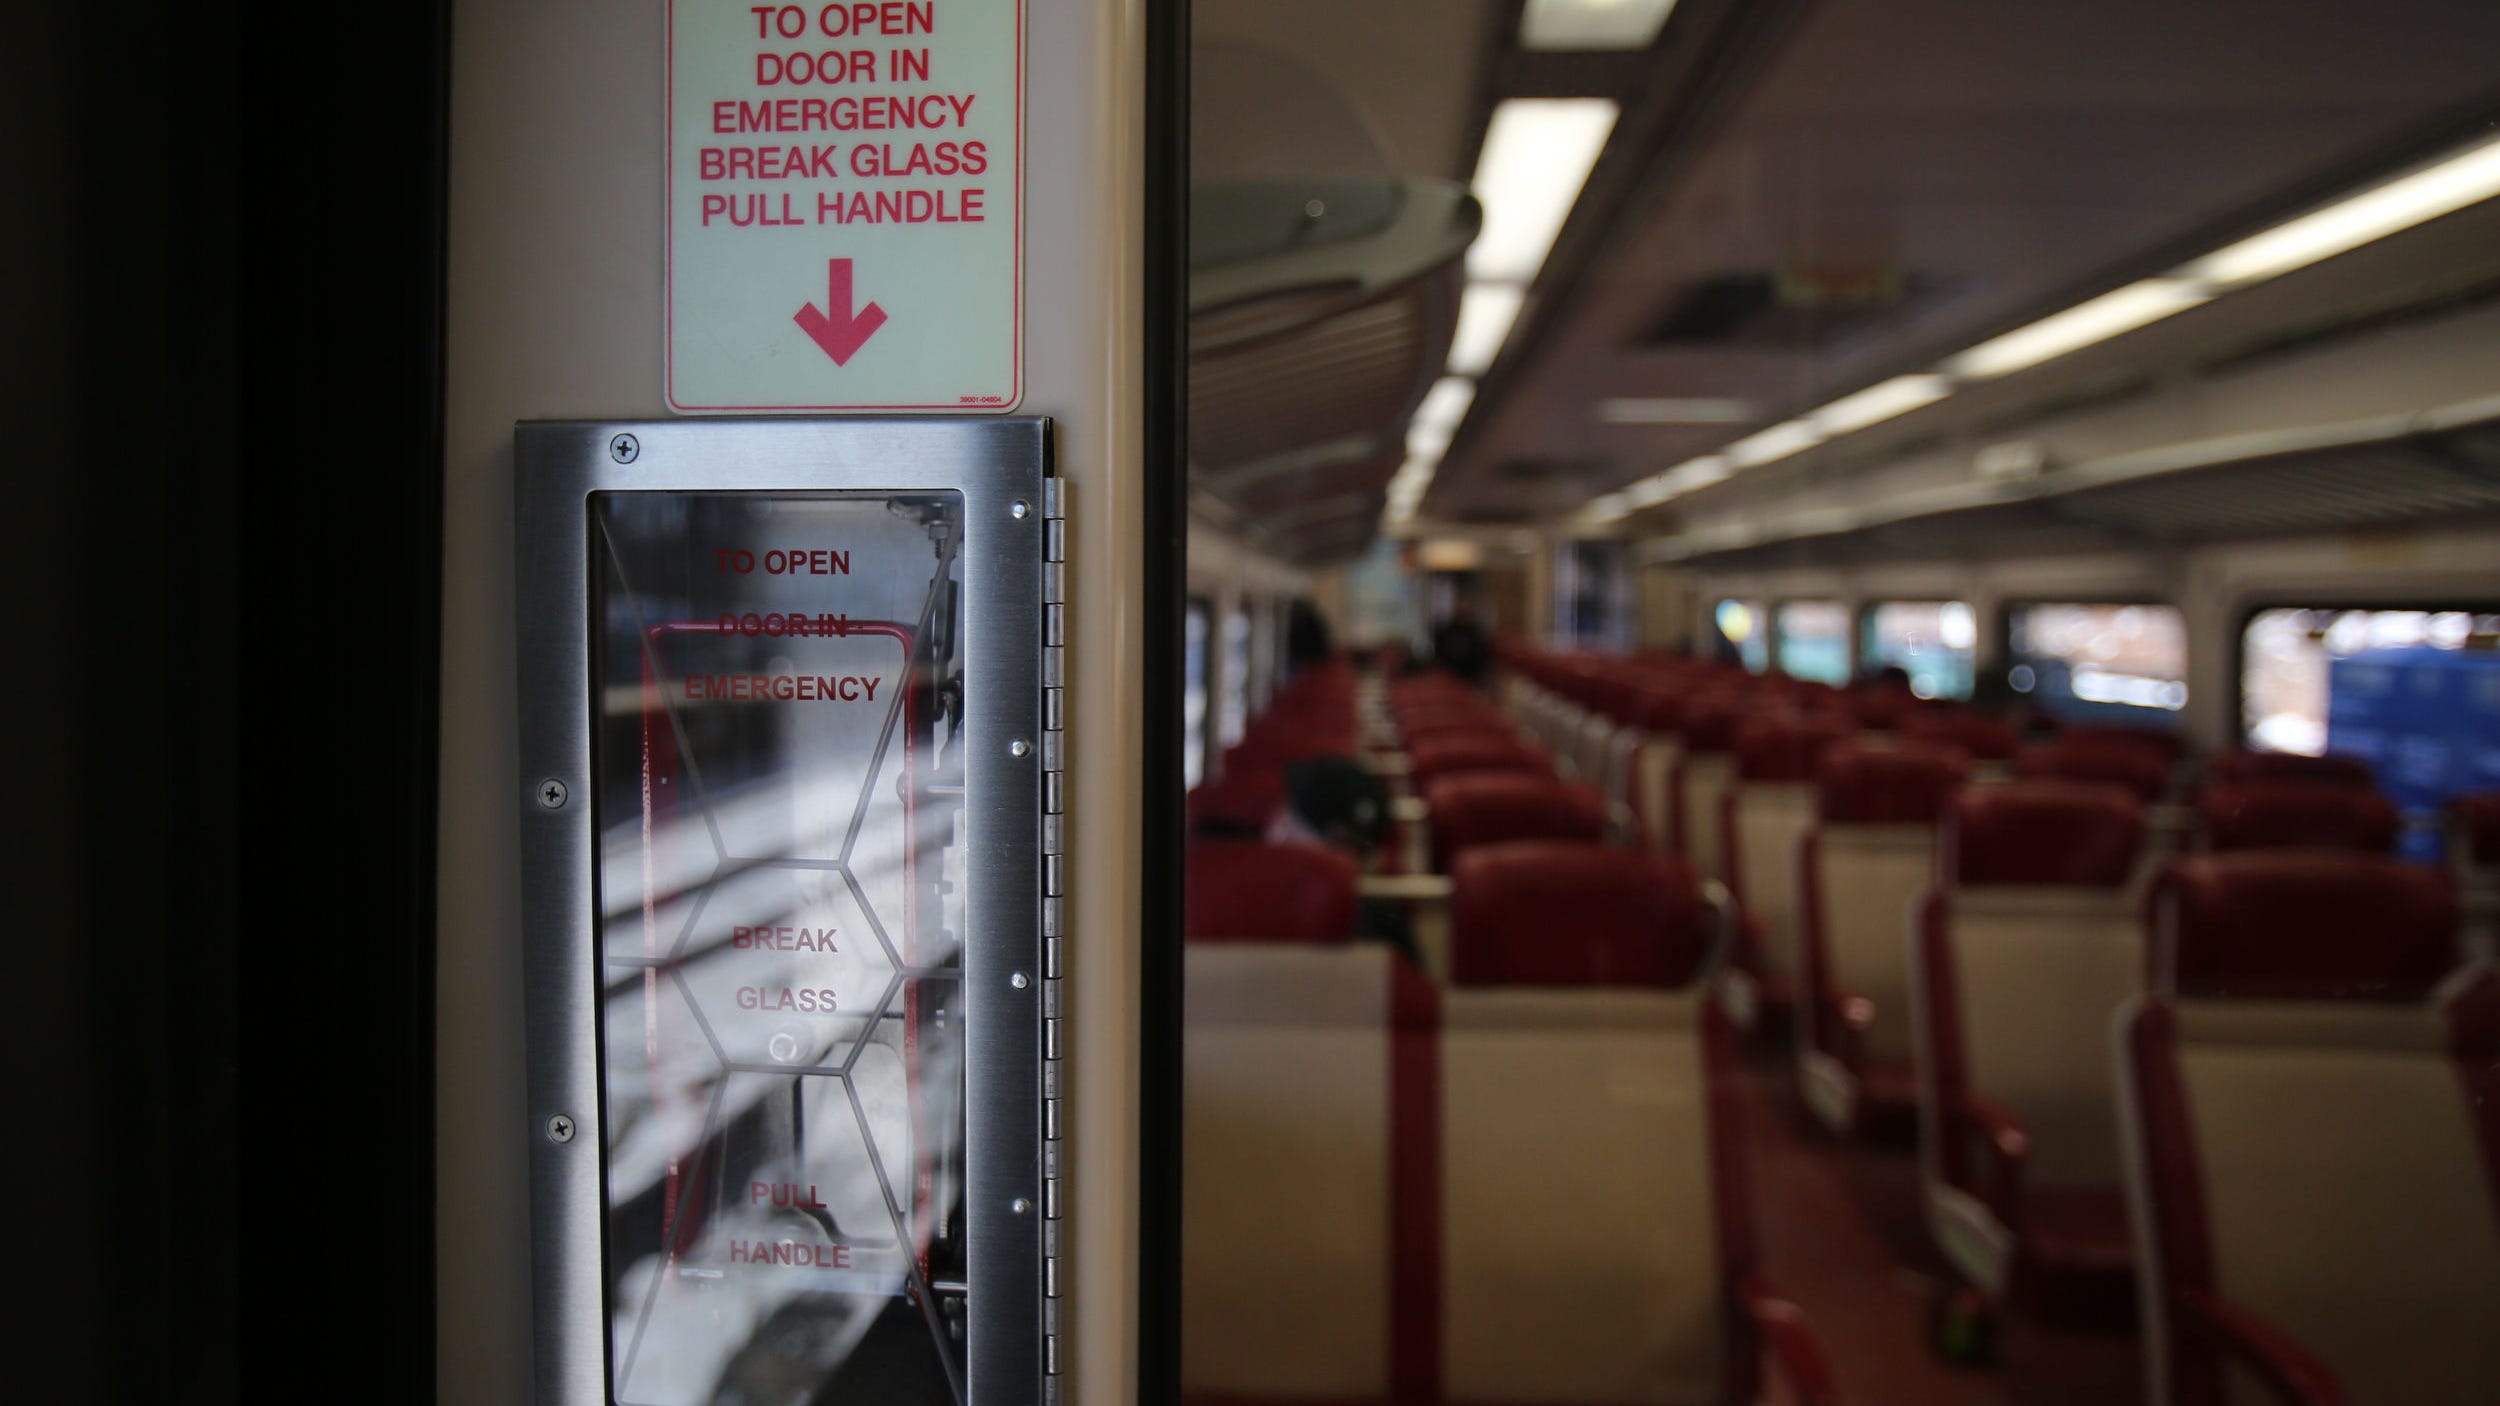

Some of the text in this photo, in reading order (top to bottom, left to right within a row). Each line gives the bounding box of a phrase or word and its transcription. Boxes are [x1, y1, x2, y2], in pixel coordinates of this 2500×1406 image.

[751, 2, 933, 38] TO OPEN
[757, 48, 928, 85] DOOR IN
[713, 94, 975, 133] EMERGENCY
[700, 141, 987, 180] BREAK GLASS
[702, 189, 984, 227] PULL HANDLE
[714, 549, 850, 575] TO OPEN
[719, 613, 847, 638] DOOR IN
[685, 675, 881, 701] EMERGENCY
[733, 926, 838, 953] BREAK
[736, 986, 838, 1013] GLASS
[751, 1182, 827, 1209] PULL
[729, 1240, 851, 1269] HANDLE
